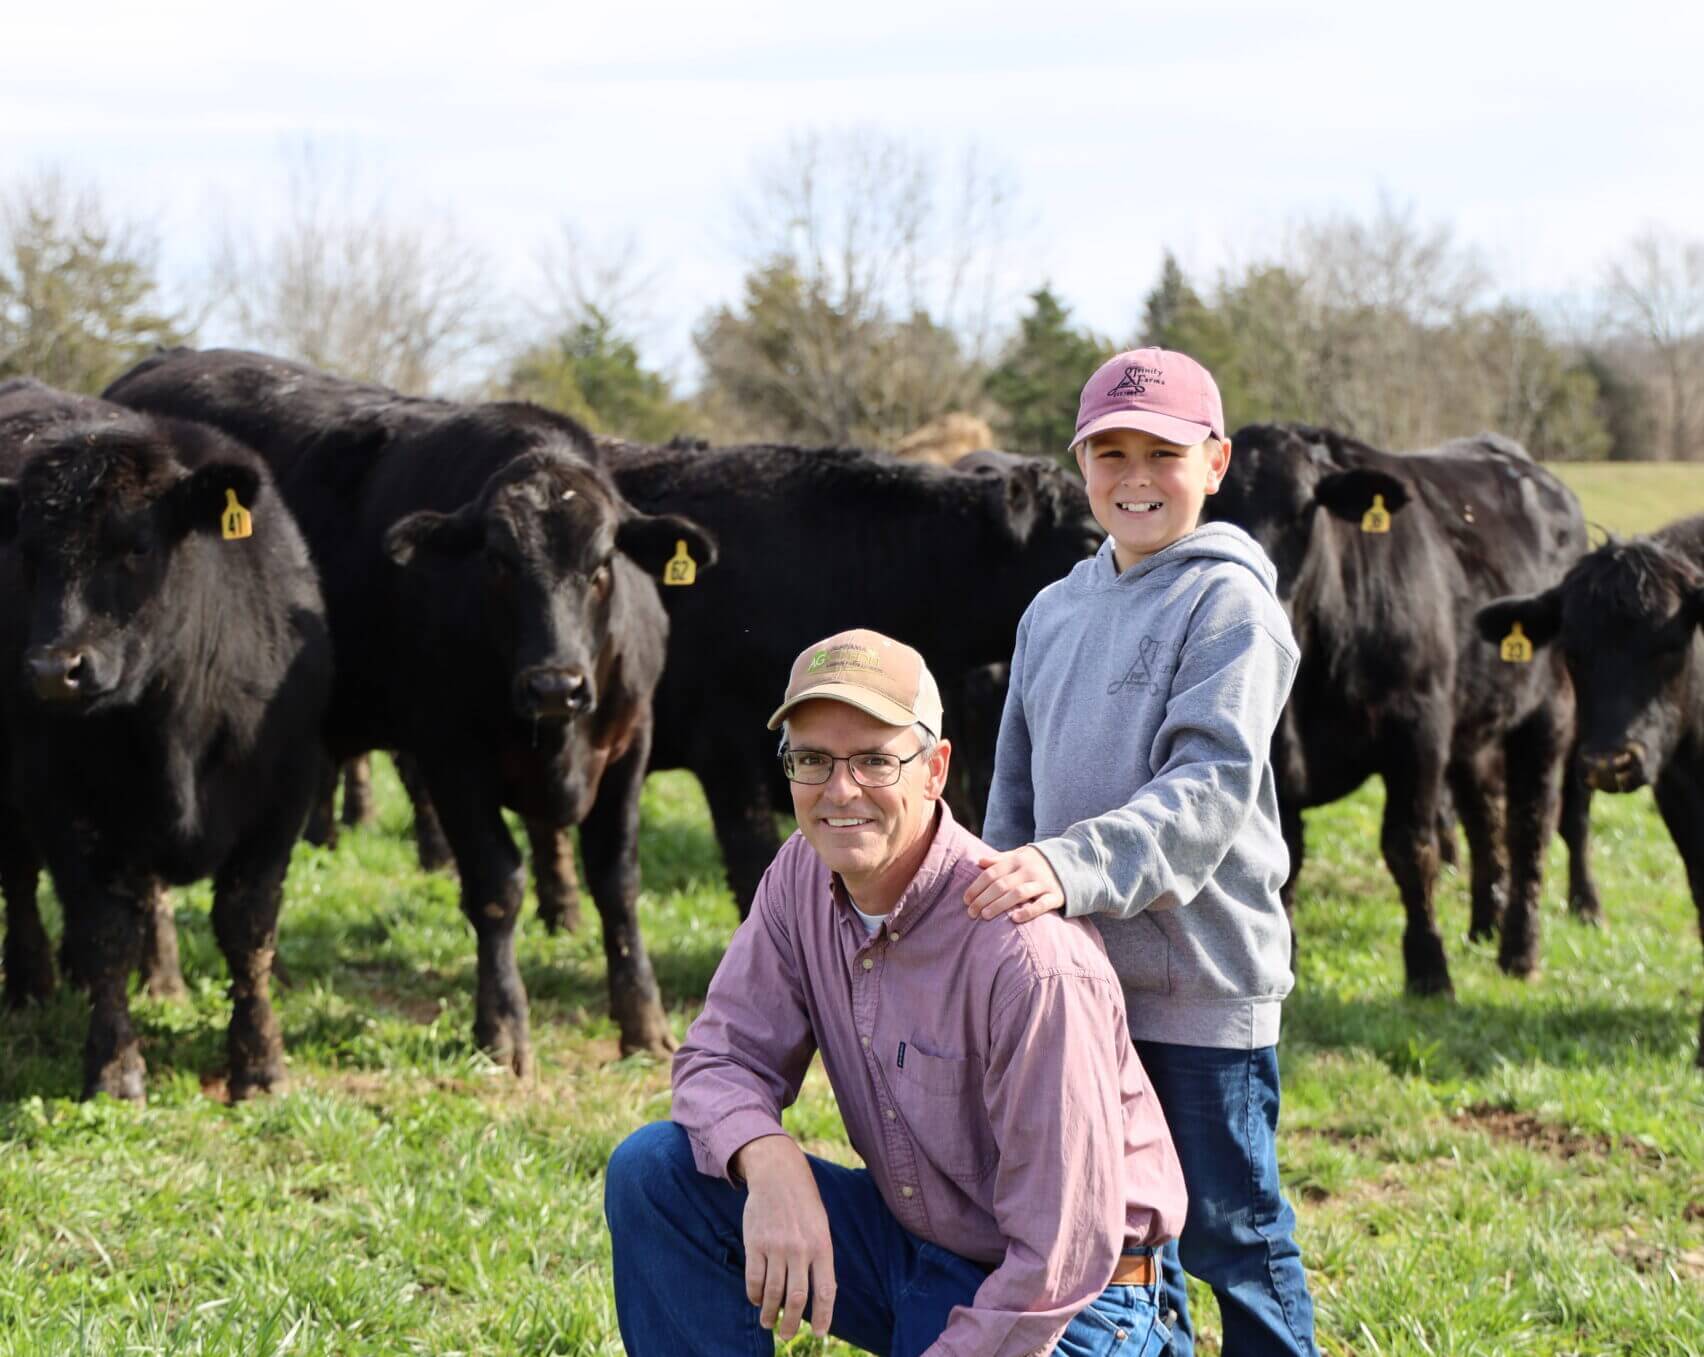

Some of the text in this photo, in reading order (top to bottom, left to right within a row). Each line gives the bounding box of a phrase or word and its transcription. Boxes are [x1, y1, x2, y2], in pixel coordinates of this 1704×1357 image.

[1136, 374, 1165, 385] Farms
[228, 512, 243, 535] 41
[671, 560, 690, 581] 62
